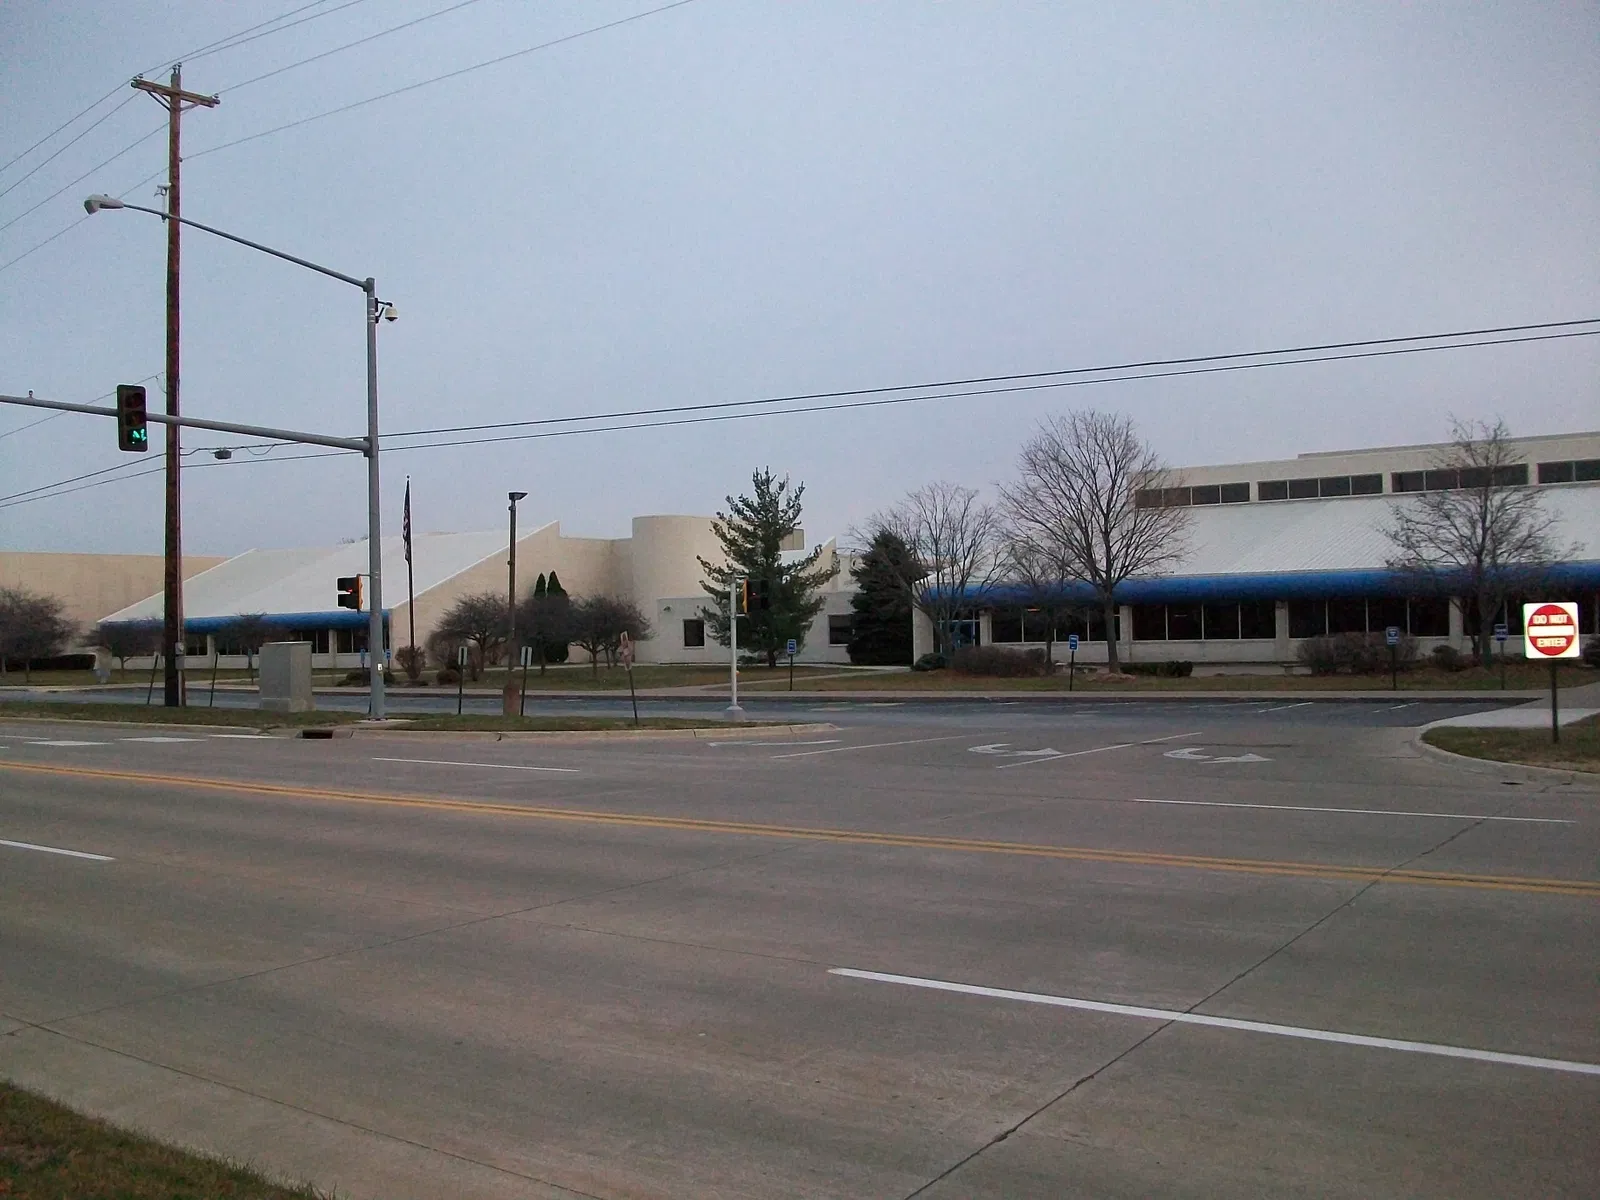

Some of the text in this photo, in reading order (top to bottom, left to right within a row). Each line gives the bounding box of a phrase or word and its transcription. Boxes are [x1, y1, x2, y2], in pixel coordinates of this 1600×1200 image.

[1532, 614, 1568, 624] DO NOT
[1536, 638, 1567, 647] ENTER
